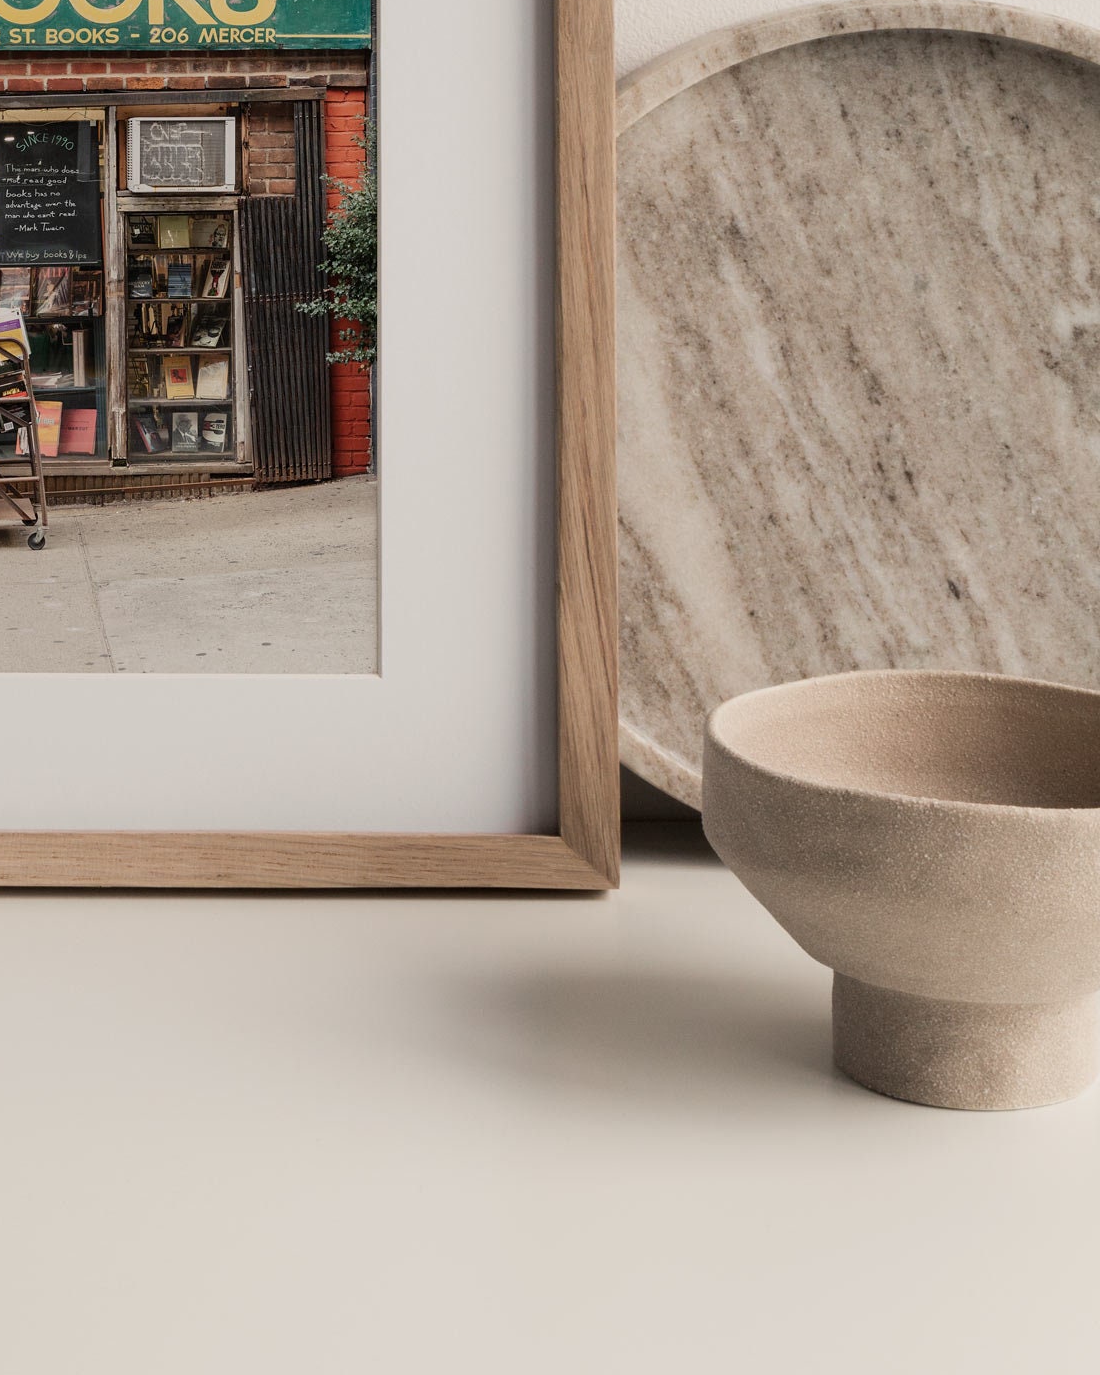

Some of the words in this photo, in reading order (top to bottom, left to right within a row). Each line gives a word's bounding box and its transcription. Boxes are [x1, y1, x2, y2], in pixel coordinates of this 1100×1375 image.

[9, 27, 36, 44] ST.
[45, 27, 120, 44] BOOKS
[149, 27, 189, 44] 206
[198, 27, 276, 44] MERCER
[15, 133, 49, 152] SINCE
[51, 134, 74, 151] 1990
[4, 164, 21, 173] The
[43, 166, 59, 174] who
[61, 165, 80, 174] does
[47, 177, 67, 186] good
[5, 189, 32, 198] books
[34, 188, 47, 197] has
[5, 200, 42, 210] advantage
[64, 199, 77, 207] the
[22, 211, 36, 219] who
[39, 222, 65, 232] Twain
[25, 250, 40, 262] buy
[43, 250, 68, 259] books
